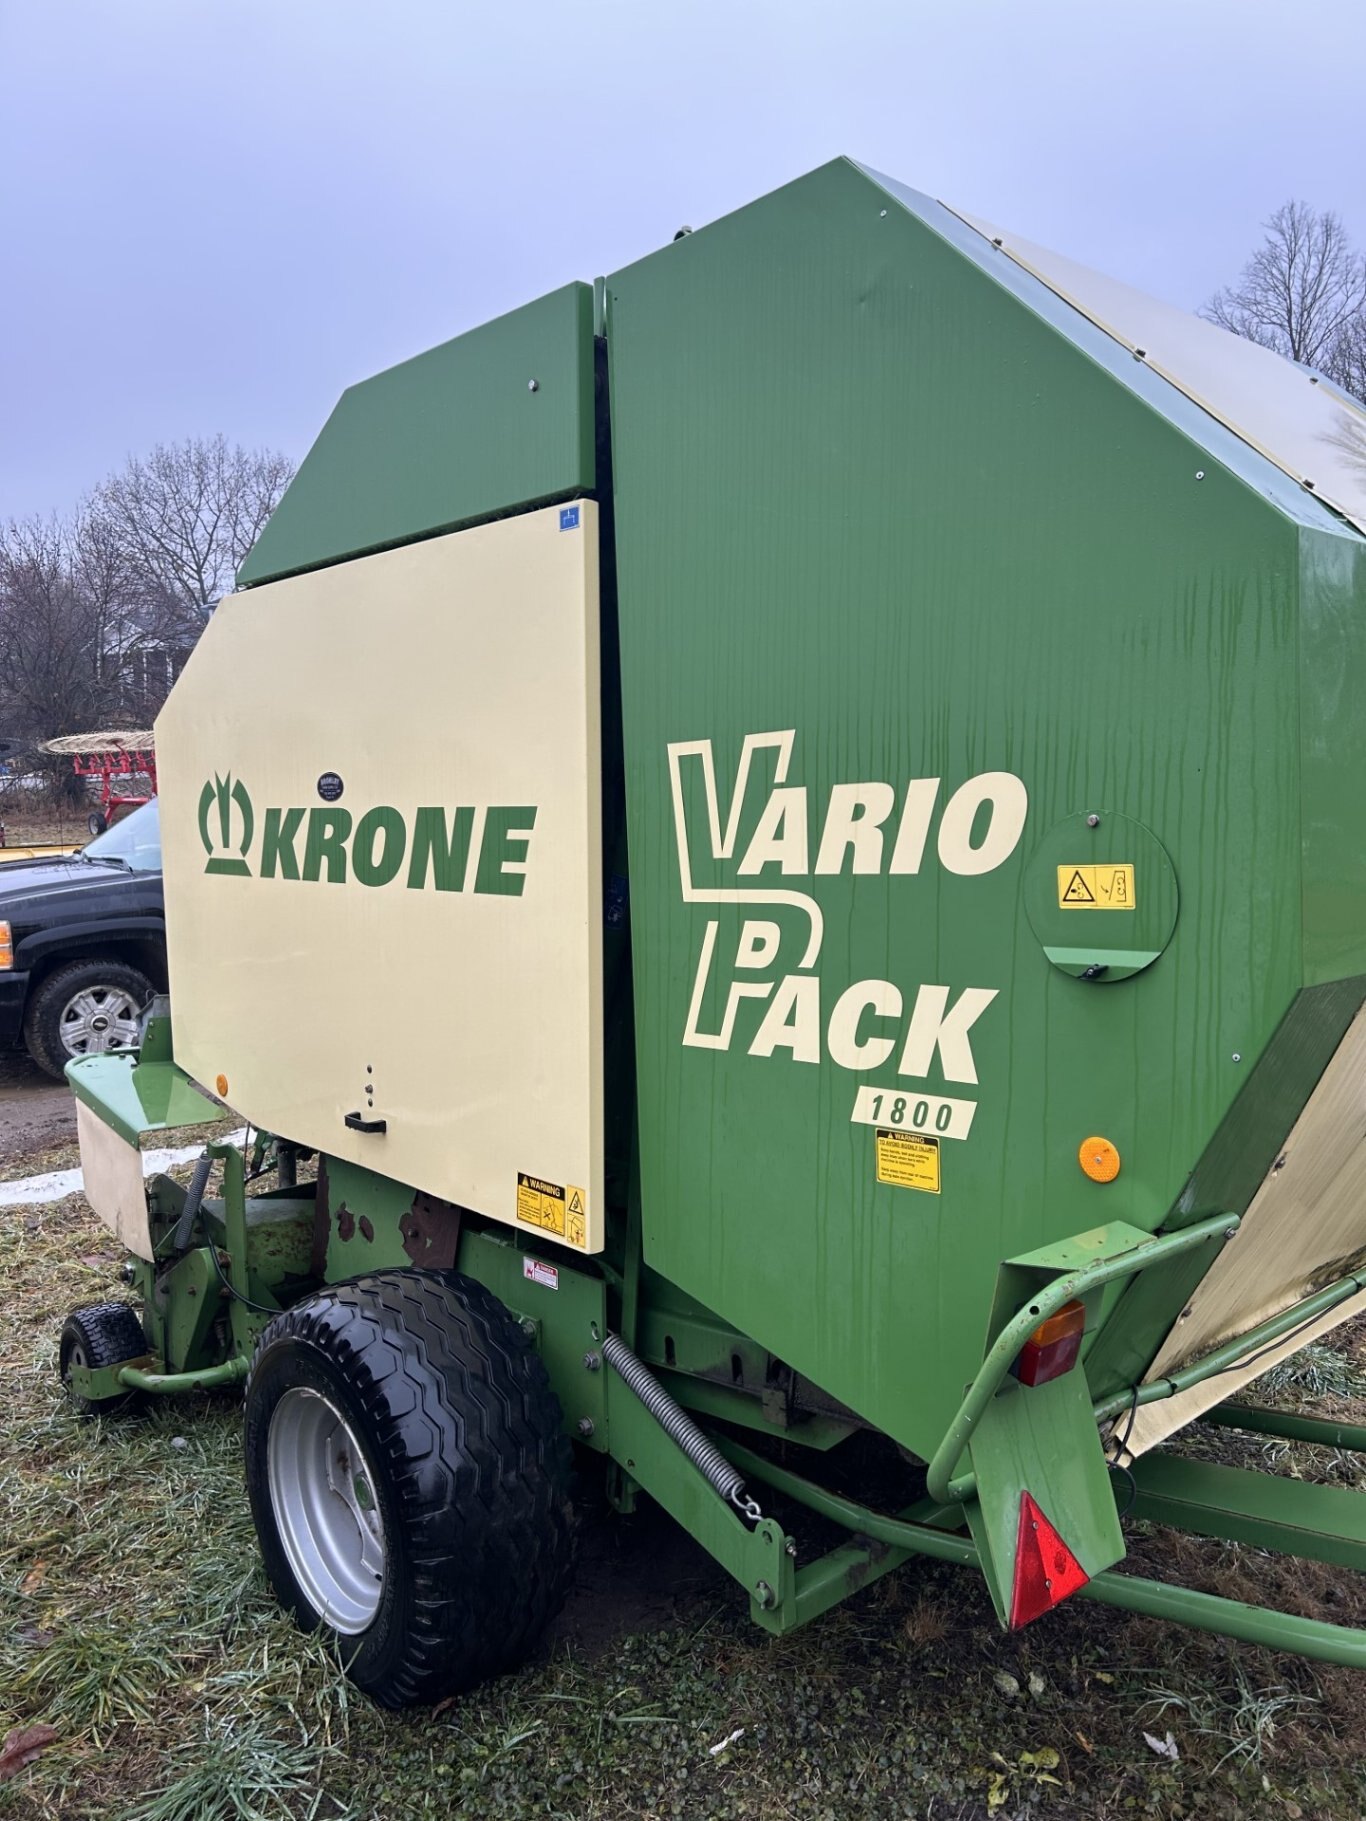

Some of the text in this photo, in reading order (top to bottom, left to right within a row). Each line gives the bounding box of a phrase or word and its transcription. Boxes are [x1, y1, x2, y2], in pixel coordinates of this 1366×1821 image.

[667, 729, 1028, 877] VARIO
[260, 806, 538, 896] KRONE
[682, 889, 1000, 1085] PACK
[872, 1095, 952, 1132] 1800
[894, 1133, 925, 1144] WARNING
[529, 1178, 561, 1197] WARNING
